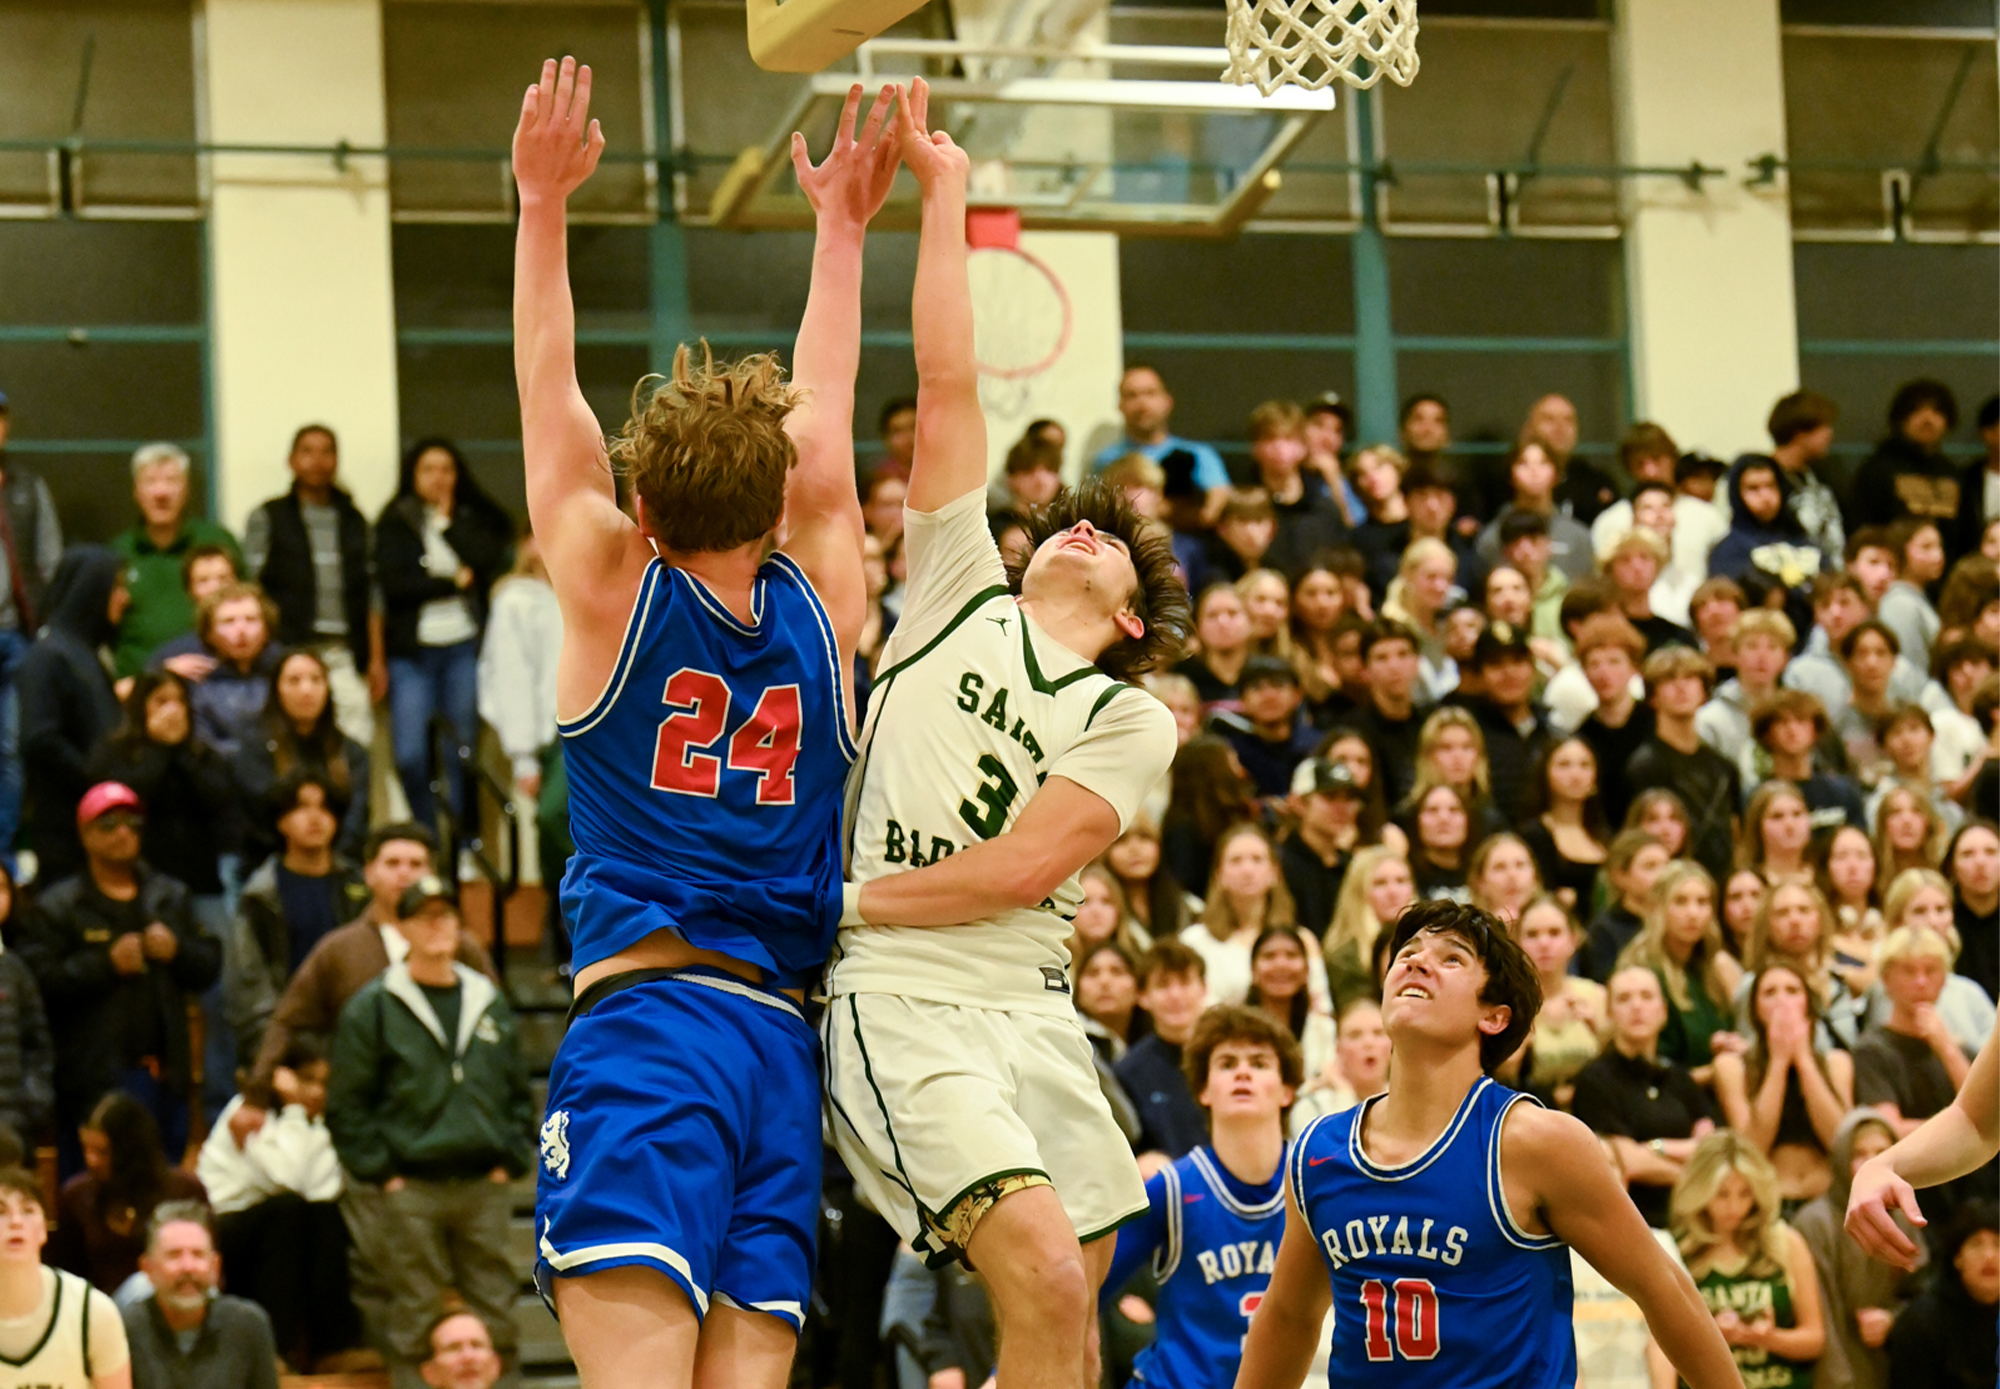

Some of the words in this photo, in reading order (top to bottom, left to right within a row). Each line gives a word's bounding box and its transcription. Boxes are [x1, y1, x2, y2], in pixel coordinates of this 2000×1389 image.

[650, 667, 803, 805] 24
[1197, 1240, 1275, 1285] ROYA
[1321, 1215, 1468, 1270] ROYALS
[1360, 1278, 1441, 1362] 10
